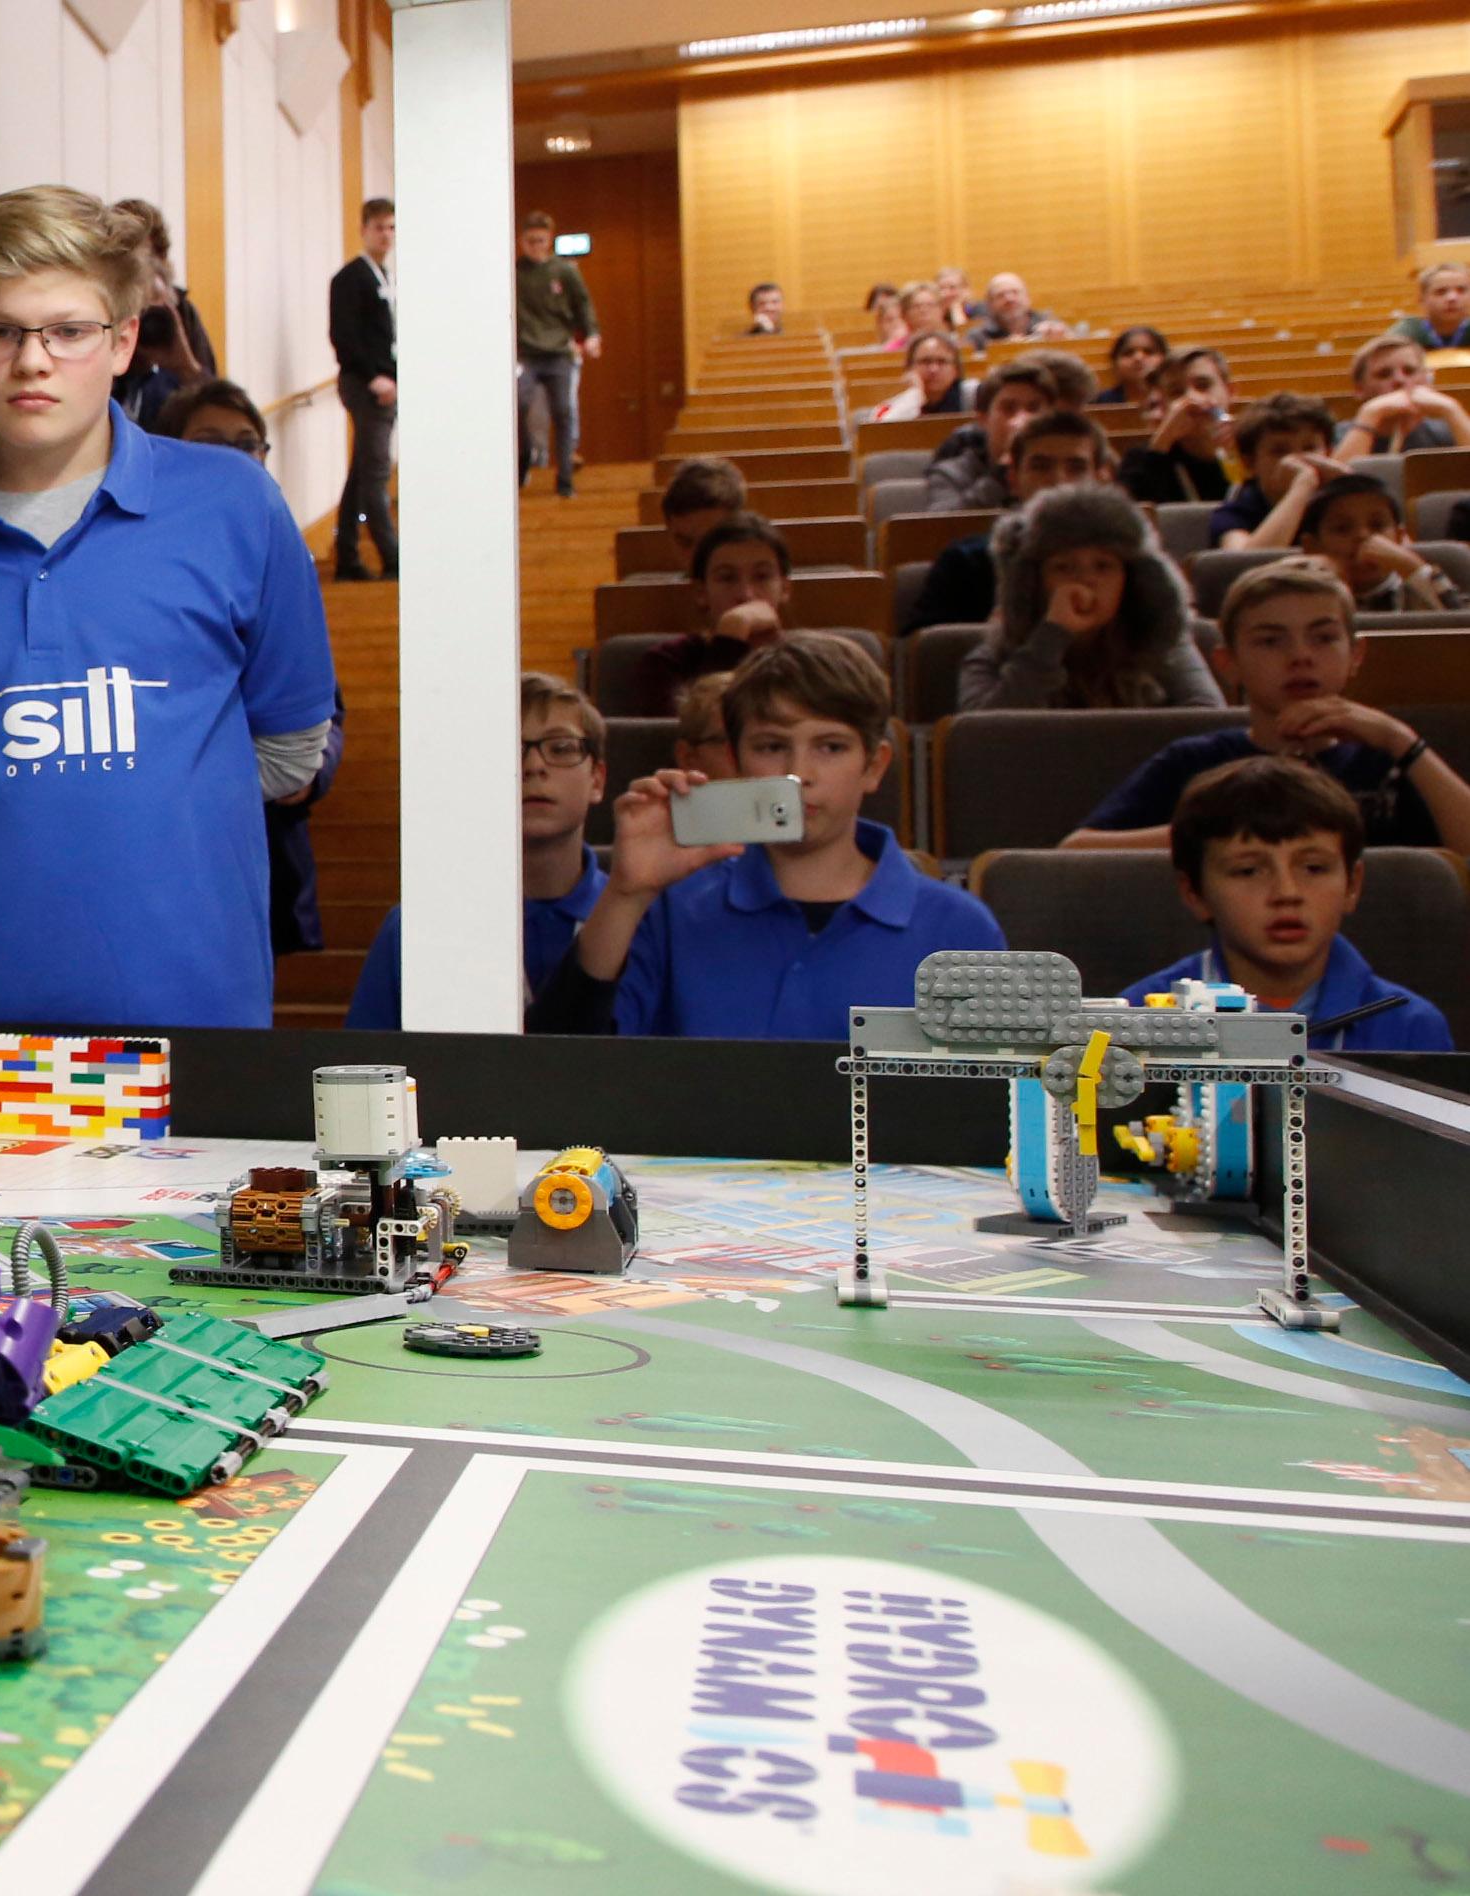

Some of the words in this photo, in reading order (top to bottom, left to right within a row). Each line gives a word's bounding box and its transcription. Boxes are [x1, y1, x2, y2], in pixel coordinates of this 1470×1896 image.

[6, 757, 136, 778] OPTICS
[673, 1577, 820, 1822] DYNAMICS
[842, 1590, 999, 1750] HYDRO
